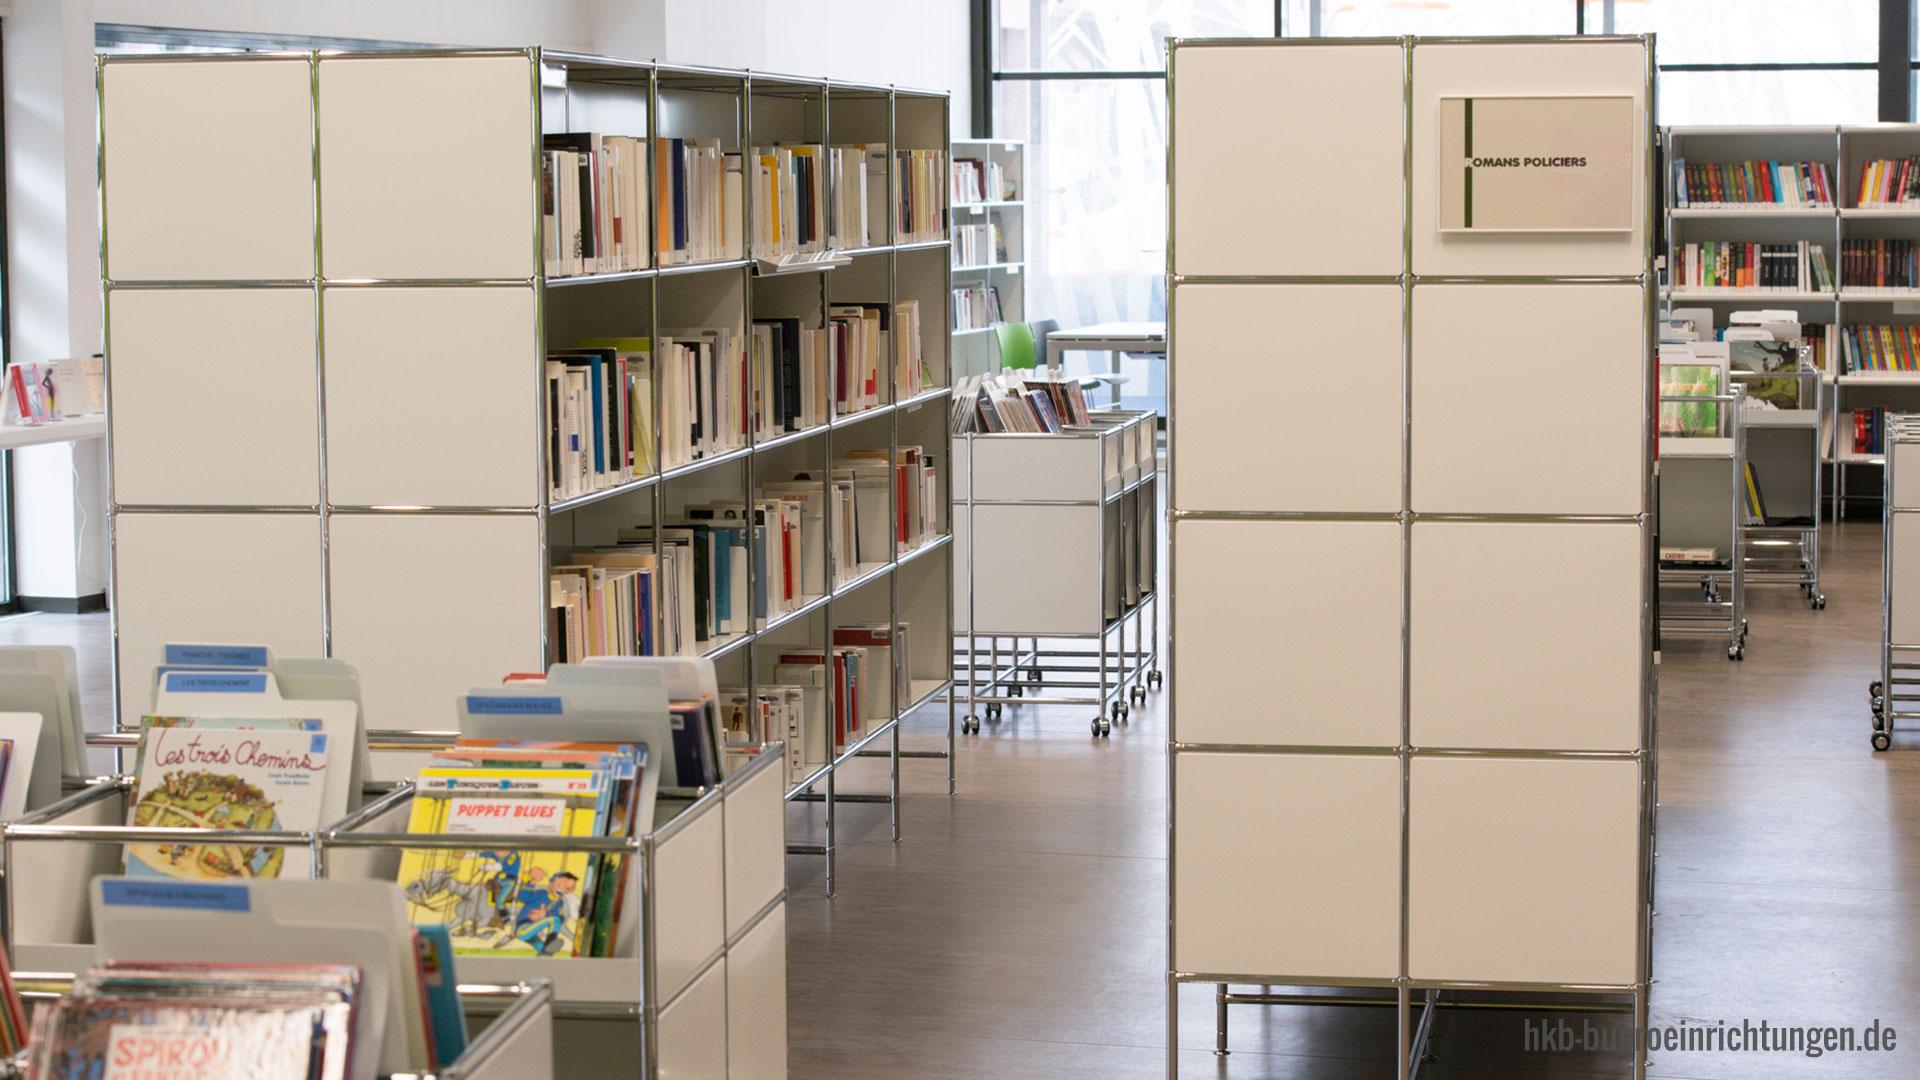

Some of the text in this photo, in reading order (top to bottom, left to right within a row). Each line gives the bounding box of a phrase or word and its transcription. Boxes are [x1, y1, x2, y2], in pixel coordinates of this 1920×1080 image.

[1524, 156, 1587, 168] POLICIERS
[235, 739, 327, 771] Chemins
[456, 804, 557, 818] PUPPET BLUES
